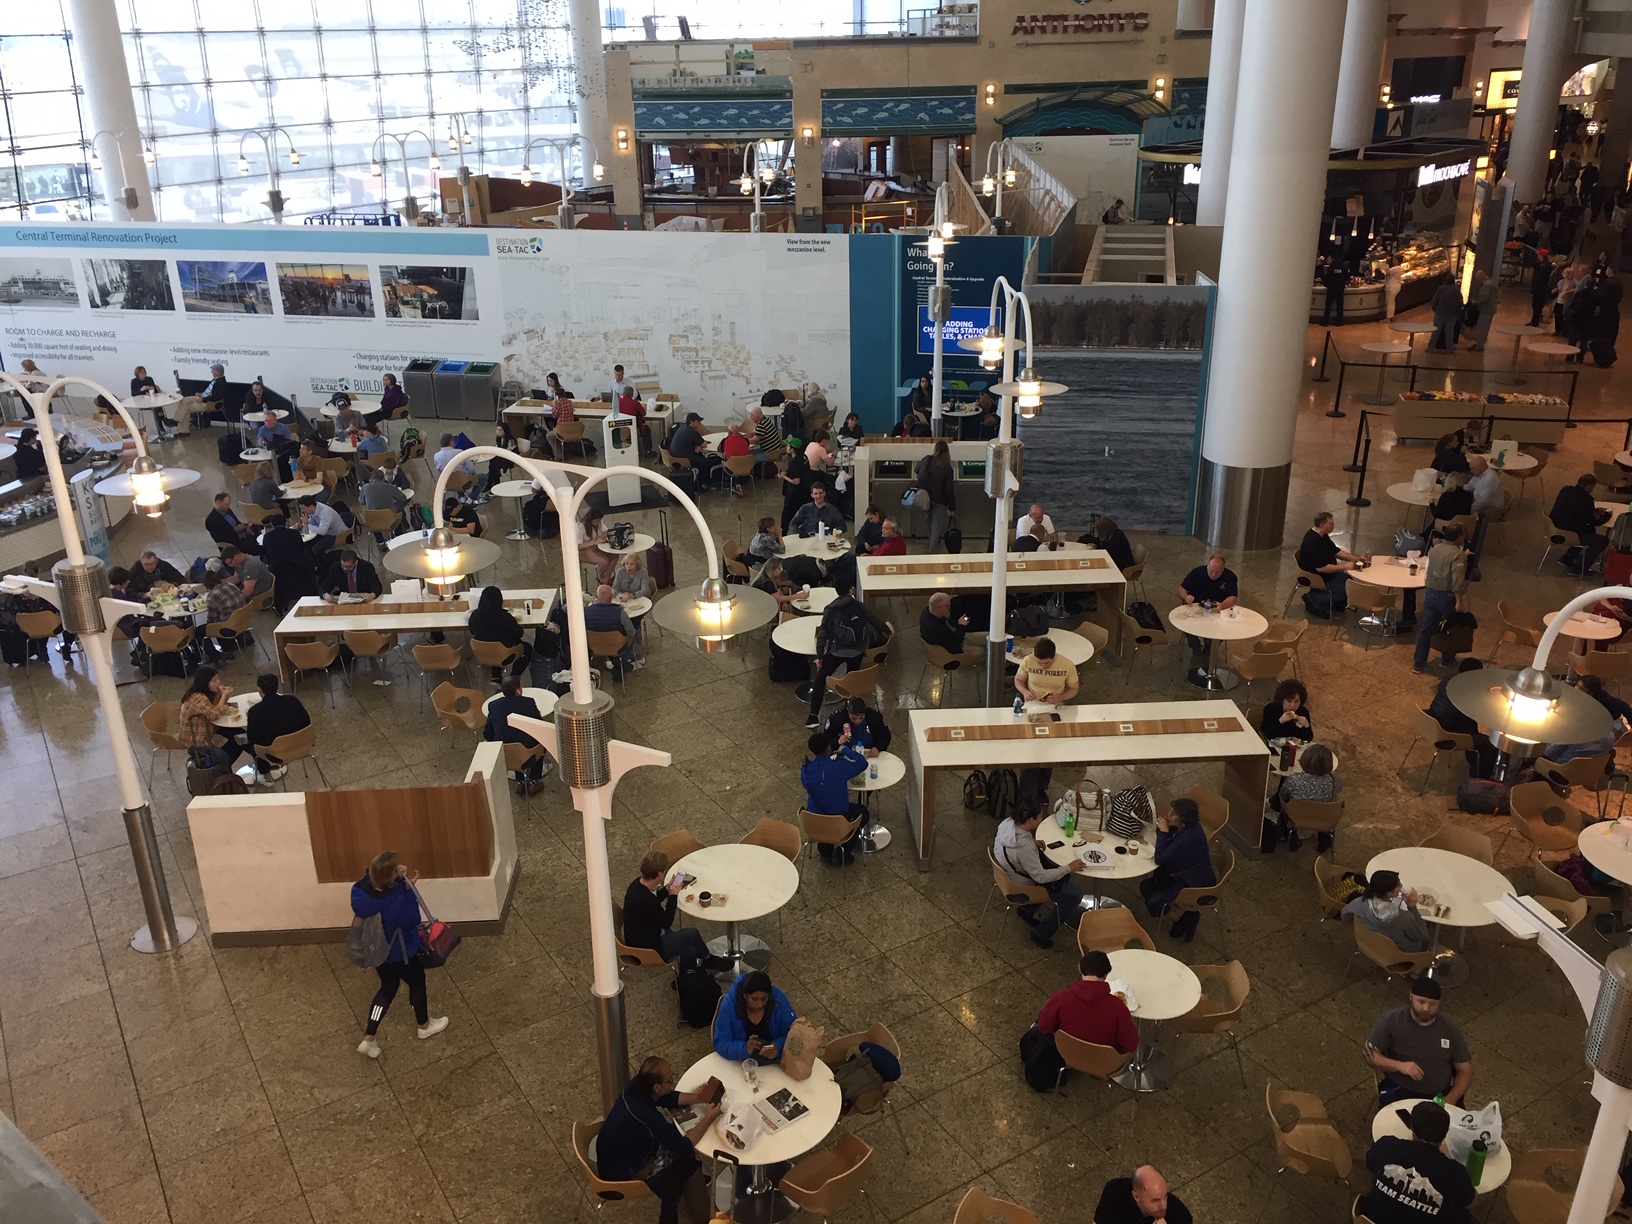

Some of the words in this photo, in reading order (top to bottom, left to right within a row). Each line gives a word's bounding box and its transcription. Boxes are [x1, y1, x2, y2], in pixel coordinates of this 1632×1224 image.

[1011, 12, 1149, 35] ANTHONY'S
[16, 230, 48, 241] Central
[49, 231, 90, 242] Terminal
[91, 232, 144, 242] Renovation
[144, 233, 178, 245] Project
[496, 237, 529, 246] DESTINATION
[907, 247, 928, 257] Wha
[907, 261, 934, 273] Going
[945, 320, 973, 328] ADDING
[5, 327, 26, 335] ROOM
[27, 328, 36, 336] TO
[37, 328, 64, 337] CHARGE
[81, 330, 117, 339] RECHARGE
[923, 326, 959, 334] CHAGING
[10, 342, 27, 350] Adding
[74, 344, 92, 352] seating
[101, 345, 118, 353] dining
[172, 346, 190, 355] Adding
[174, 356, 191, 364] Family
[191, 357, 210, 365] friendly
[356, 352, 379, 363] Charging
[380, 353, 400, 362] stations
[400, 354, 408, 362] for
[369, 364, 384, 373] stage
[310, 377, 338, 385] DESTINATION
[354, 379, 384, 392] BUILDI
[1044, 669, 1067, 677] FOREST
[1375, 1178, 1398, 1199] TEAM
[1397, 1194, 1440, 1216] SEATTLE
